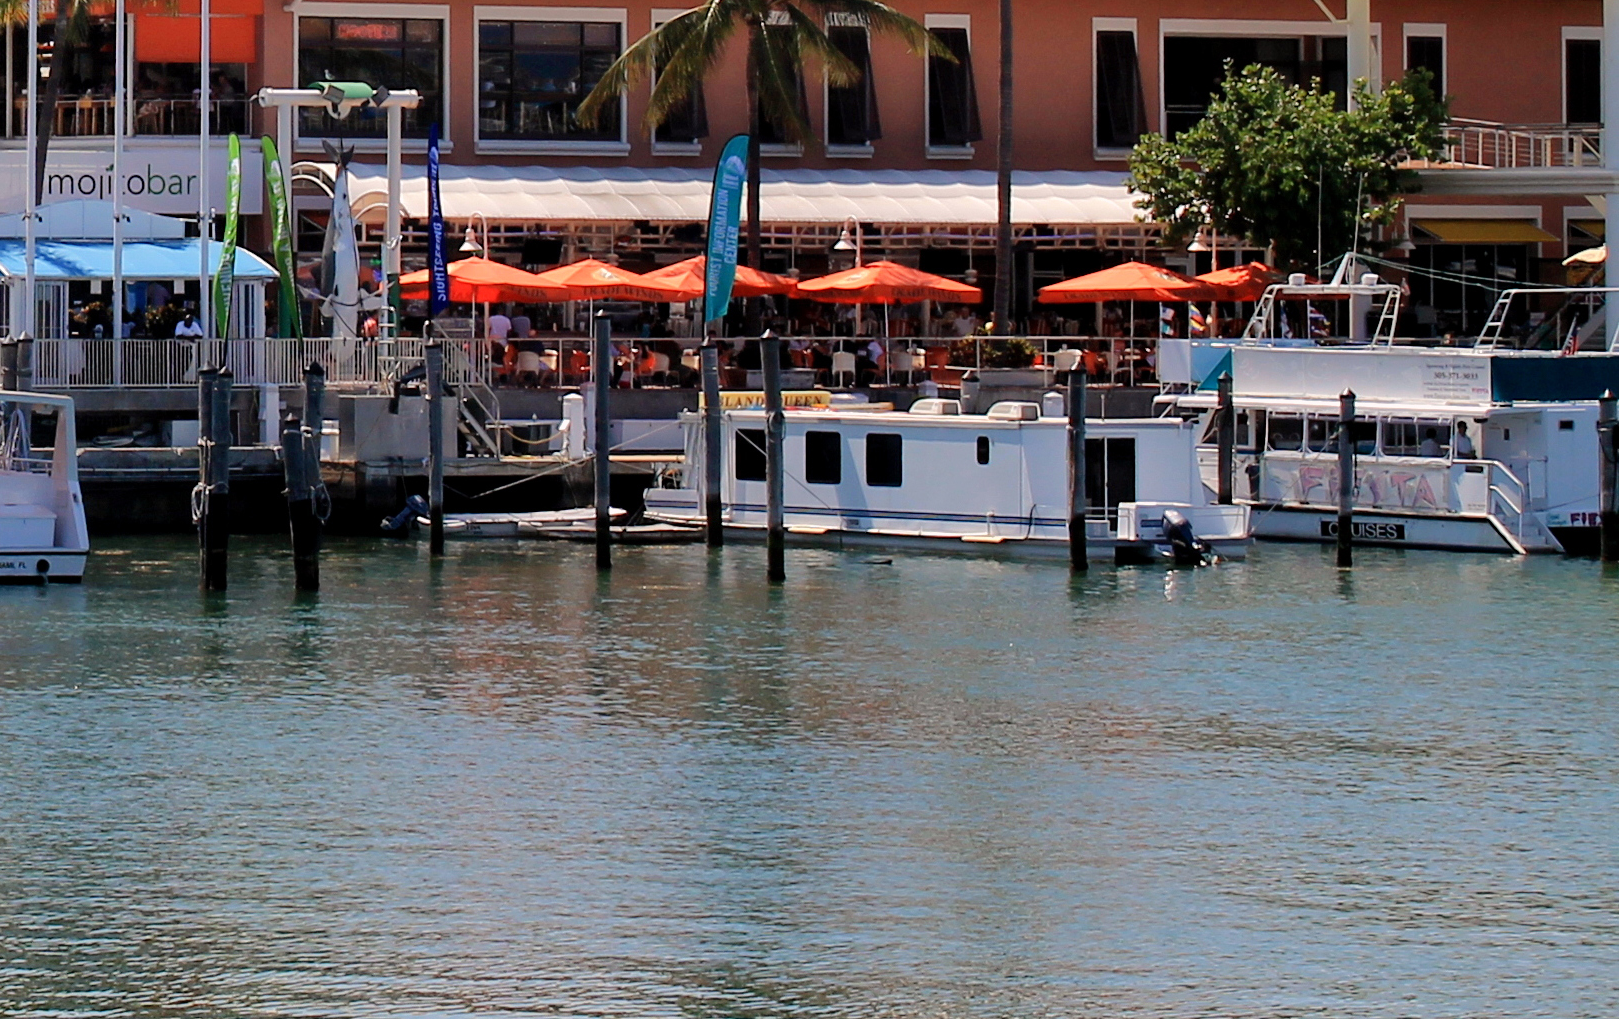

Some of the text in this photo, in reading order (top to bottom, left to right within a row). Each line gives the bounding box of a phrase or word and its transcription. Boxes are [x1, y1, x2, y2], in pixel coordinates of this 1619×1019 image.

[48, 164, 197, 200] mojiobar
[724, 225, 738, 264] CENTER
[718, 394, 822, 407] SLAND UEEN
[1327, 523, 1399, 540] CUISES
